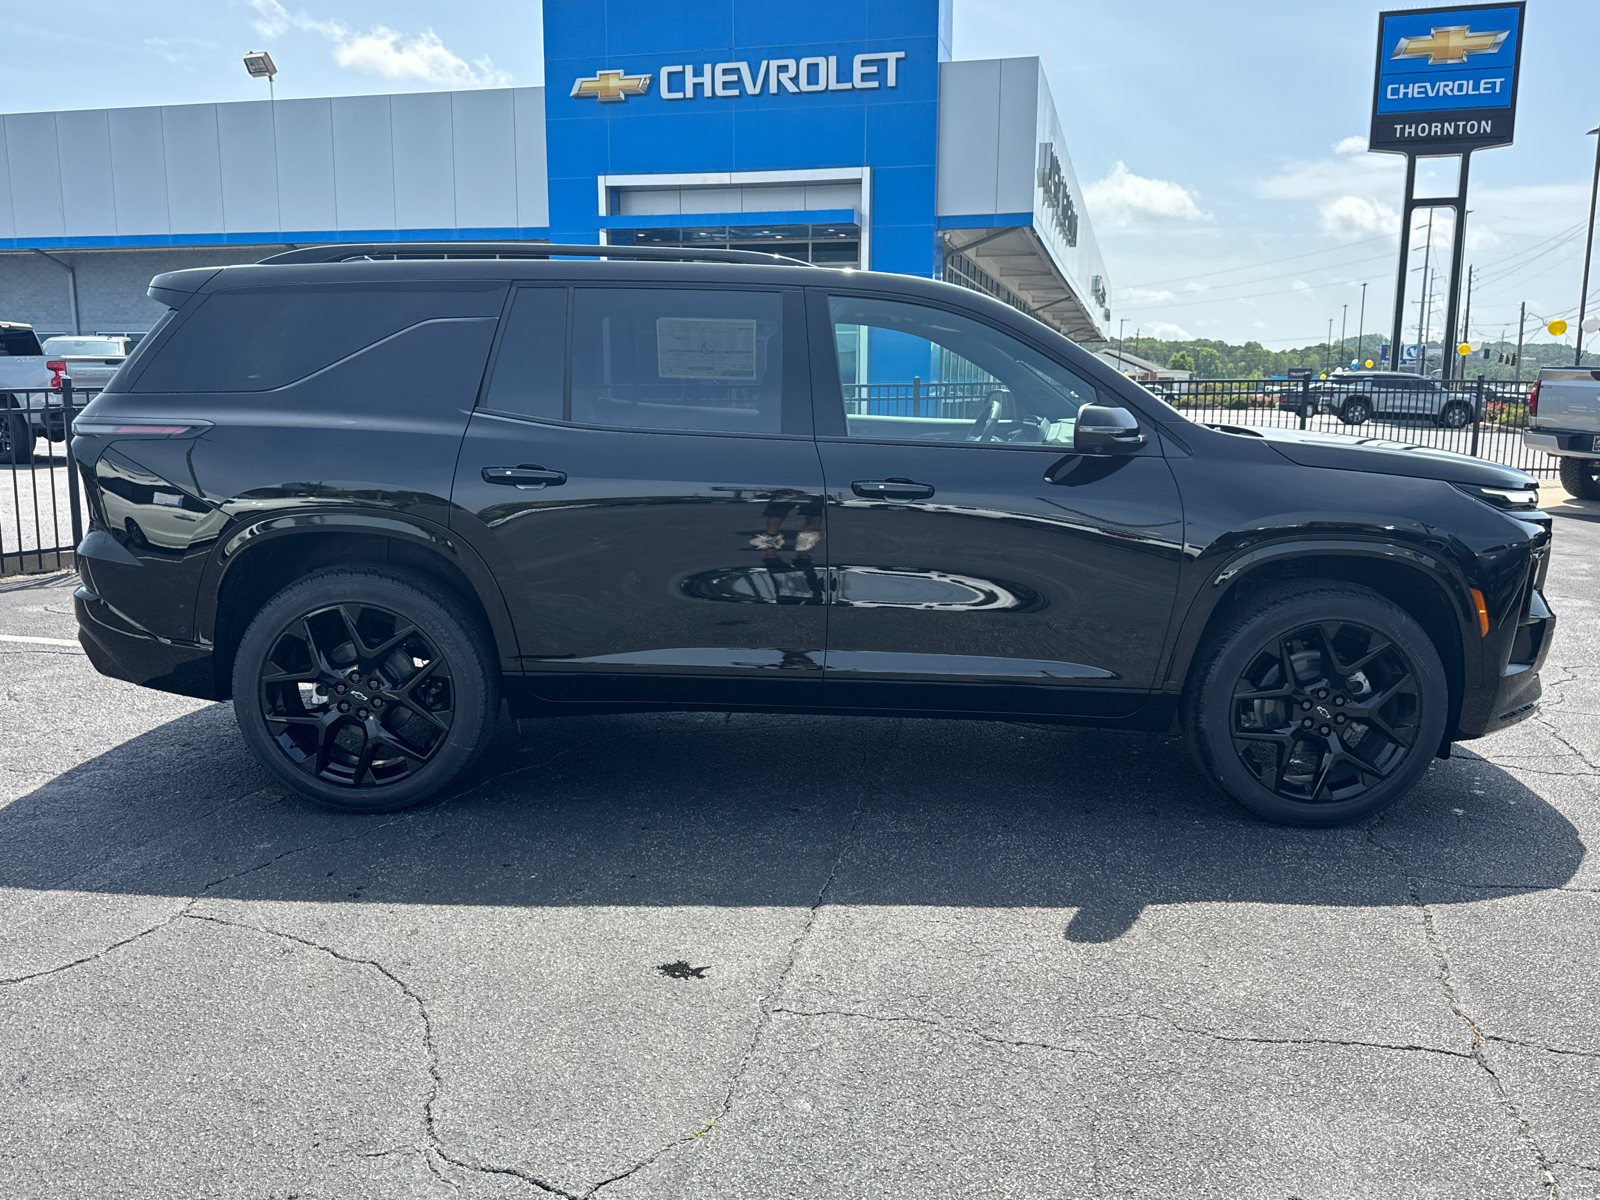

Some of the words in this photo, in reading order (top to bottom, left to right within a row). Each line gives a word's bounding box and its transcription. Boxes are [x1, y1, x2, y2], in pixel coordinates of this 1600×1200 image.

[660, 51, 905, 99] CHEVROLET
[1387, 78, 1505, 99] CHEVROLET
[1394, 120, 1492, 138] THORNTON
